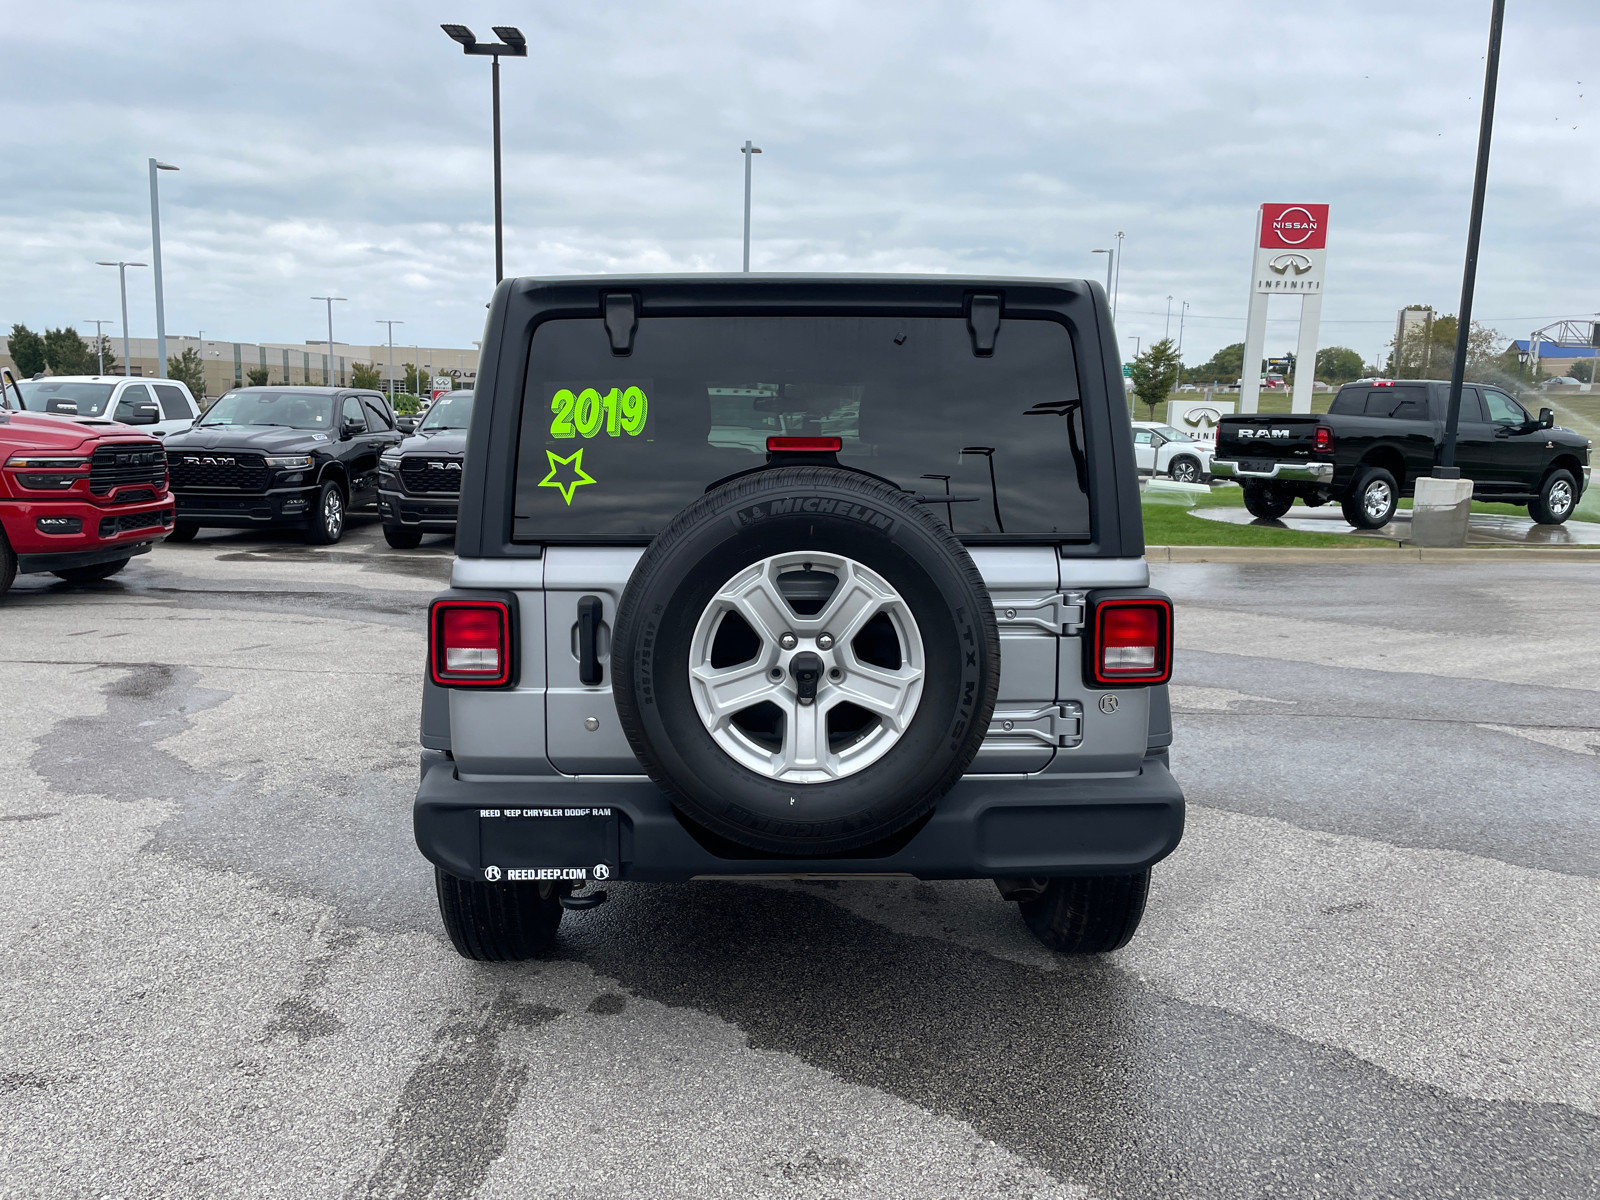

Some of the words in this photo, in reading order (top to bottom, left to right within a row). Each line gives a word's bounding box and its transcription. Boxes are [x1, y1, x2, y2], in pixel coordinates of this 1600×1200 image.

[1258, 280, 1320, 289] INFINITI
[550, 386, 648, 438] 2019
[1238, 429, 1290, 438] RAM
[116, 453, 154, 464] RAM
[183, 457, 236, 466] RAM
[427, 462, 464, 470] RA
[770, 498, 894, 530] MICHELIN
[955, 606, 976, 667] LTX
[641, 621, 656, 705] 245/75R17
[480, 809, 501, 817] REED
[522, 809, 563, 817] CHRYSLER
[592, 808, 611, 816] RAM
[507, 869, 587, 881] REEDJEEP.COM
